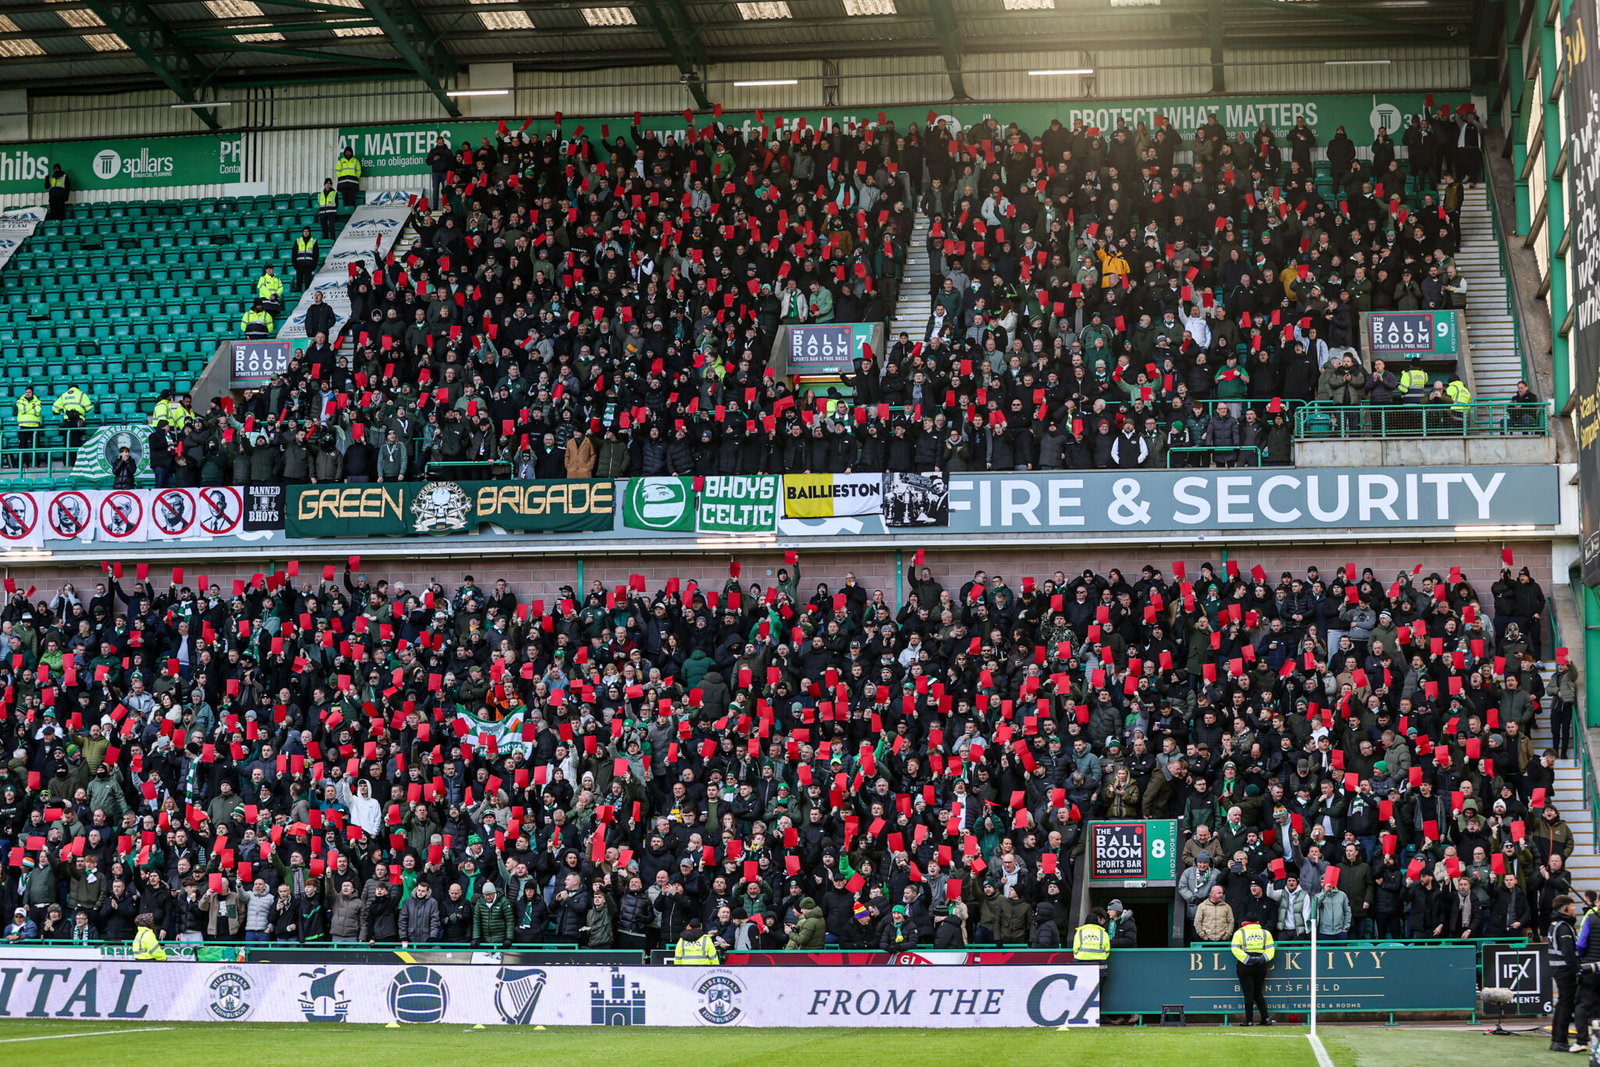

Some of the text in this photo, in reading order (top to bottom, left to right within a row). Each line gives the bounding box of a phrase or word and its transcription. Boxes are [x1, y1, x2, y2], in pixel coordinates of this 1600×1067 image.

[1226, 102, 1318, 128] MATTERS
[376, 158, 387, 167] no
[388, 156, 424, 168] obligation
[1373, 321, 1428, 333] BALL
[1436, 322, 1449, 337] 9
[793, 333, 847, 346] BALL
[855, 335, 867, 350] 7
[1373, 332, 1430, 344] ROOM
[235, 349, 286, 361] BALL
[793, 345, 848, 356] ROOM
[235, 360, 287, 371] ROOM
[249, 486, 281, 496] BANNED
[706, 476, 775, 500] BHOYS
[786, 482, 880, 500] BAILLIESTON
[299, 487, 403, 520] GREEN
[476, 482, 614, 516] BRIGADE
[948, 472, 1506, 527] FIRE & SECURITY
[248, 511, 279, 522] BHOYS
[702, 503, 773, 526] CELTIC
[1096, 834, 1141, 847] BALL
[1096, 847, 1142, 859] ROOM
[1151, 838, 1166, 859] 8
[1096, 859, 1142, 868] SPORTS BAR
[1190, 951, 1387, 971] BLK IVY
[1503, 959, 1531, 983] IFX
[0, 967, 149, 1018] ITAL
[1234, 984, 1340, 992] BNTSFIELD
[807, 989, 1005, 1015] FROM THE
